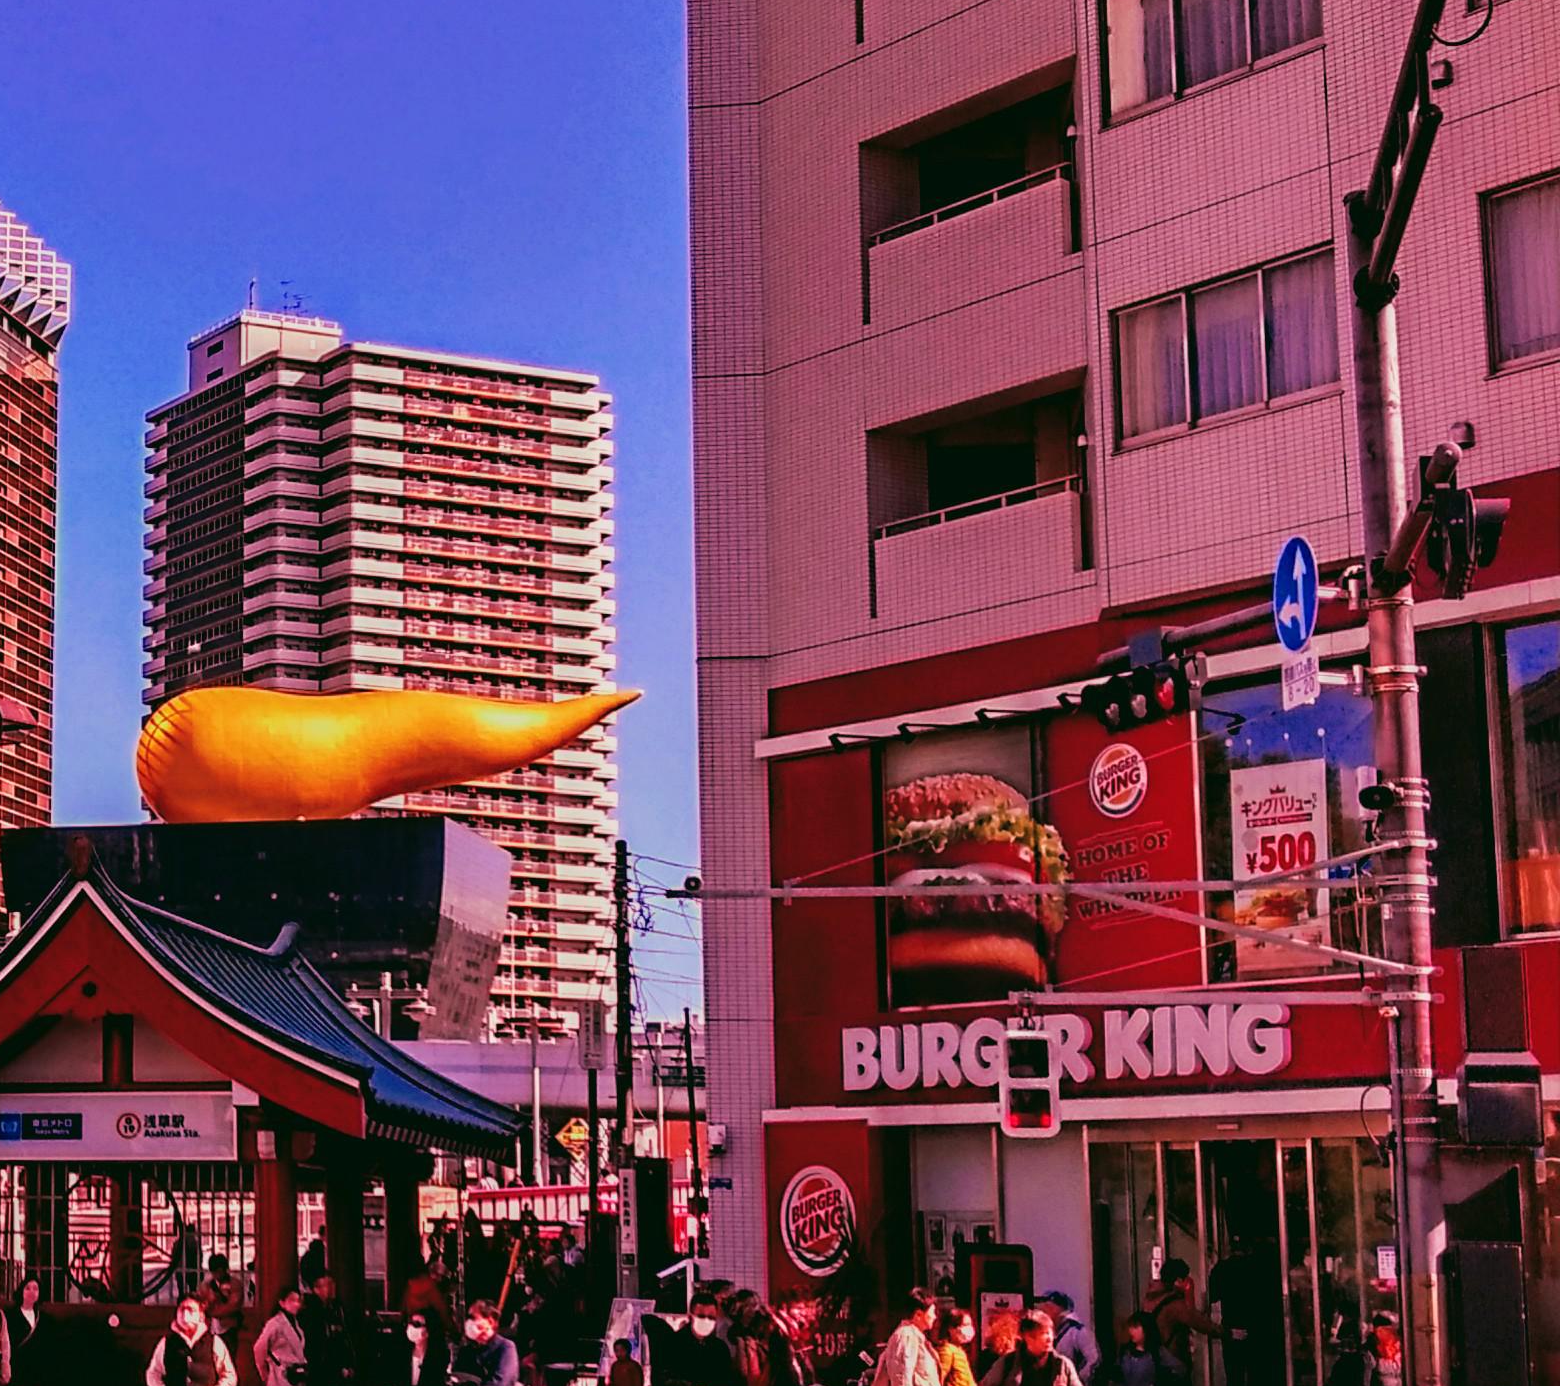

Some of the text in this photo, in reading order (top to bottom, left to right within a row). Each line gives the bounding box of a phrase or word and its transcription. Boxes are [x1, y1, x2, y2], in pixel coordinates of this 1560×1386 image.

[1096, 755, 1138, 785] BURGER
[1099, 767, 1141, 803] KING
[1077, 830, 1170, 865] HOME OF
[1246, 831, 1316, 874] ¥500
[1103, 863, 1149, 884] THE
[842, 1003, 1291, 1092] BURGR KING
[143, 1128, 181, 1138] Asakusa
[791, 1189, 842, 1225] BURGER
[794, 1206, 845, 1249] KING
